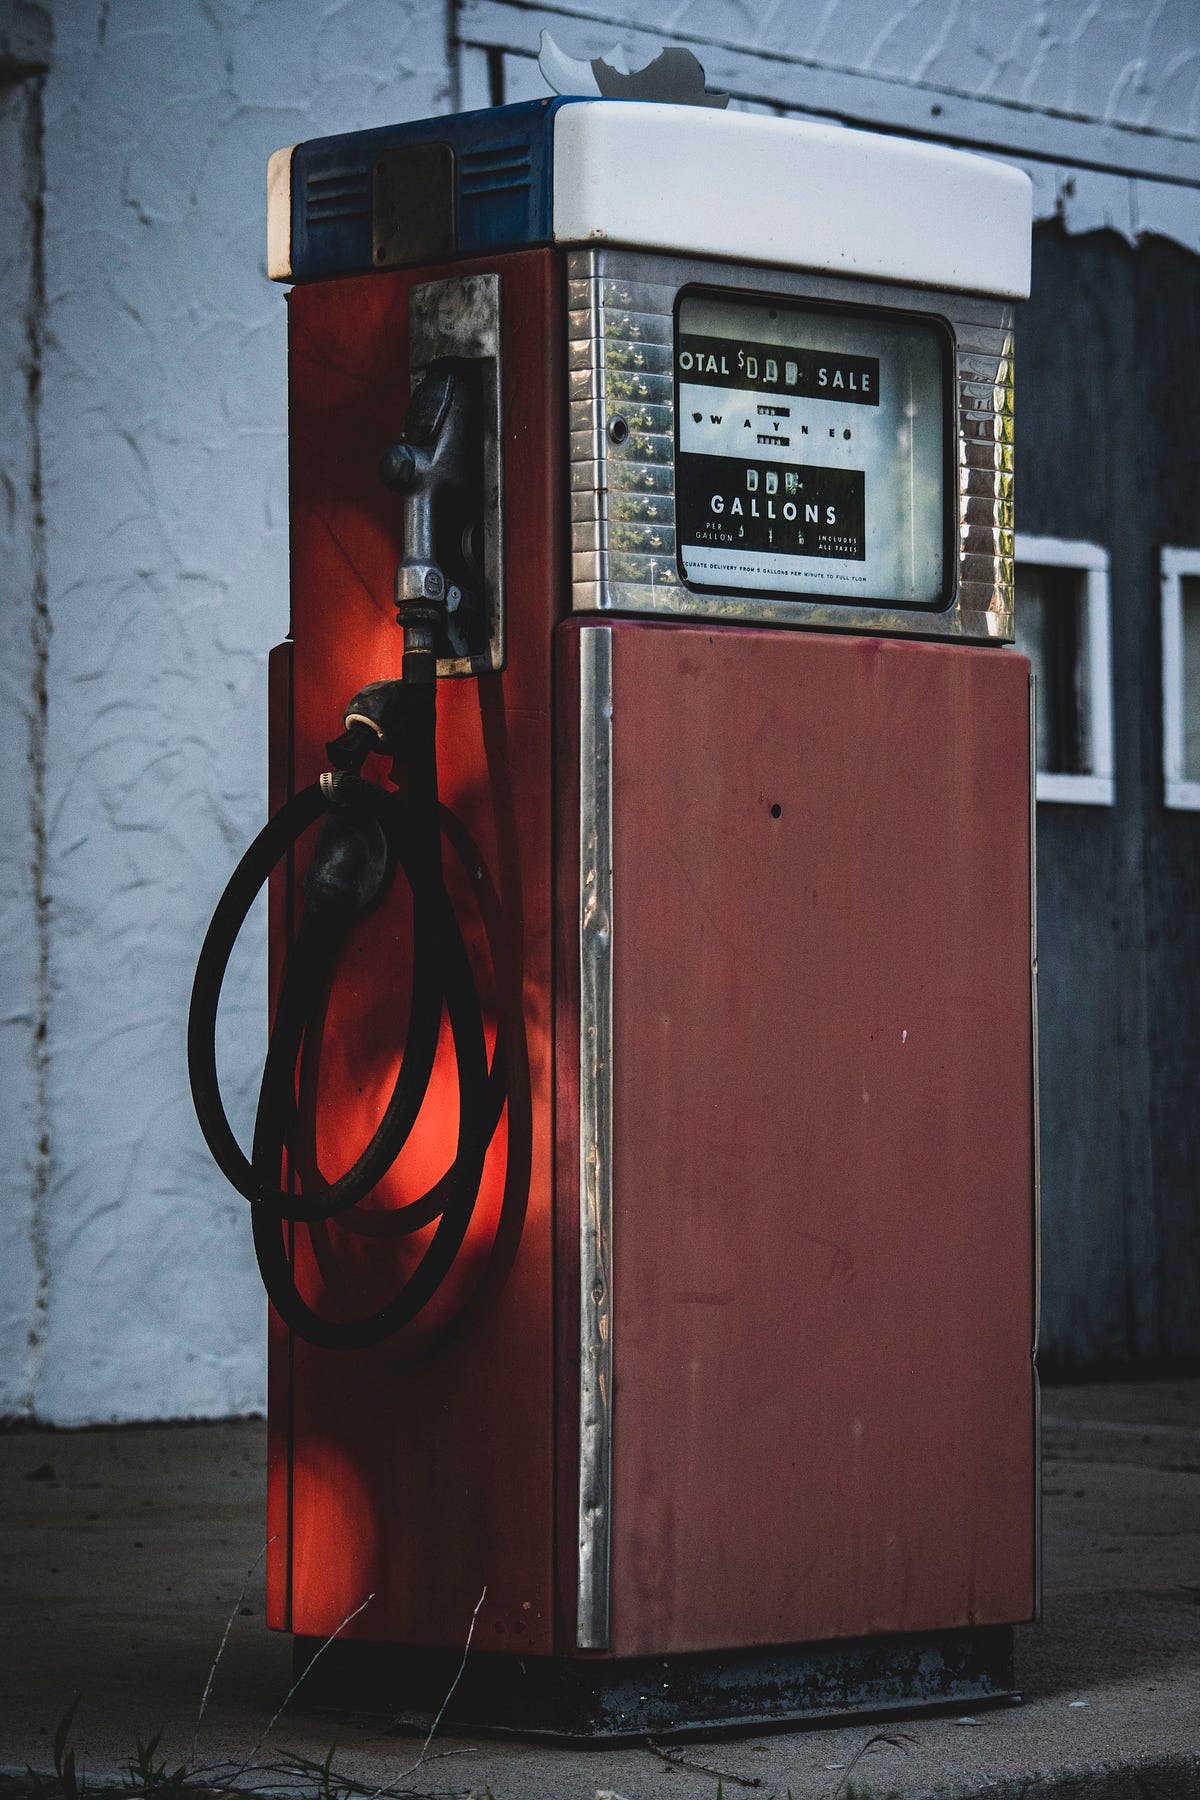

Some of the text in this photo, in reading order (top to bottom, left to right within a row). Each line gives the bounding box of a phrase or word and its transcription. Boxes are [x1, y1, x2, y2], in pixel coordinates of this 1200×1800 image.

[679, 351, 730, 375] OTAL
[818, 367, 870, 392] SALE
[710, 415, 835, 438] WAYNE
[710, 494, 836, 525] GALLONS
[706, 522, 722, 531] PER
[695, 532, 733, 542] GALLON
[818, 535, 857, 545] INCLUDES
[710, 563, 736, 571] DELIVERY
